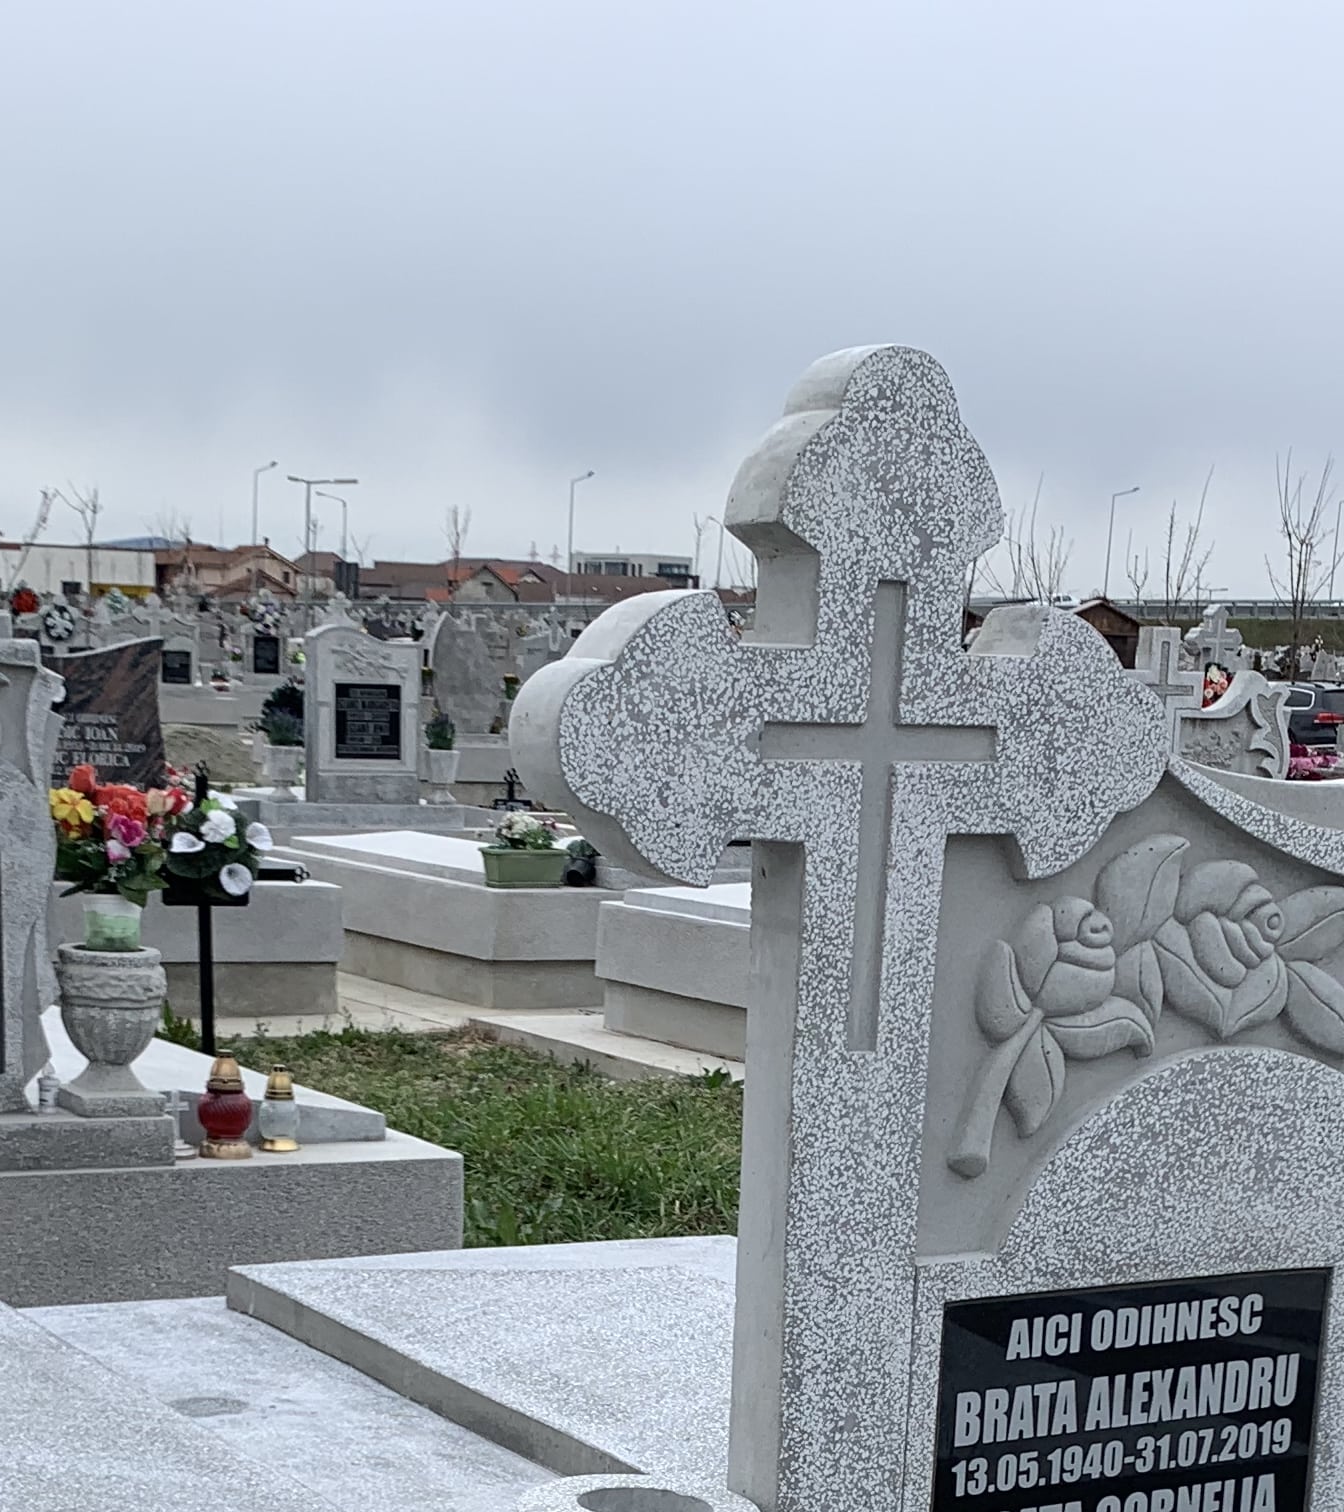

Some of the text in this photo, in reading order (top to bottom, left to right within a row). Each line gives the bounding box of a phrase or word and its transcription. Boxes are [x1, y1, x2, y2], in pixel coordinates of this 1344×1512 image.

[1006, 1293, 1264, 1361] AICI ODIHNESC
[954, 1353, 1301, 1448] BRATA ALEXANDRU
[951, 1417, 1292, 1497] 13.05.1940-31.07.2019
